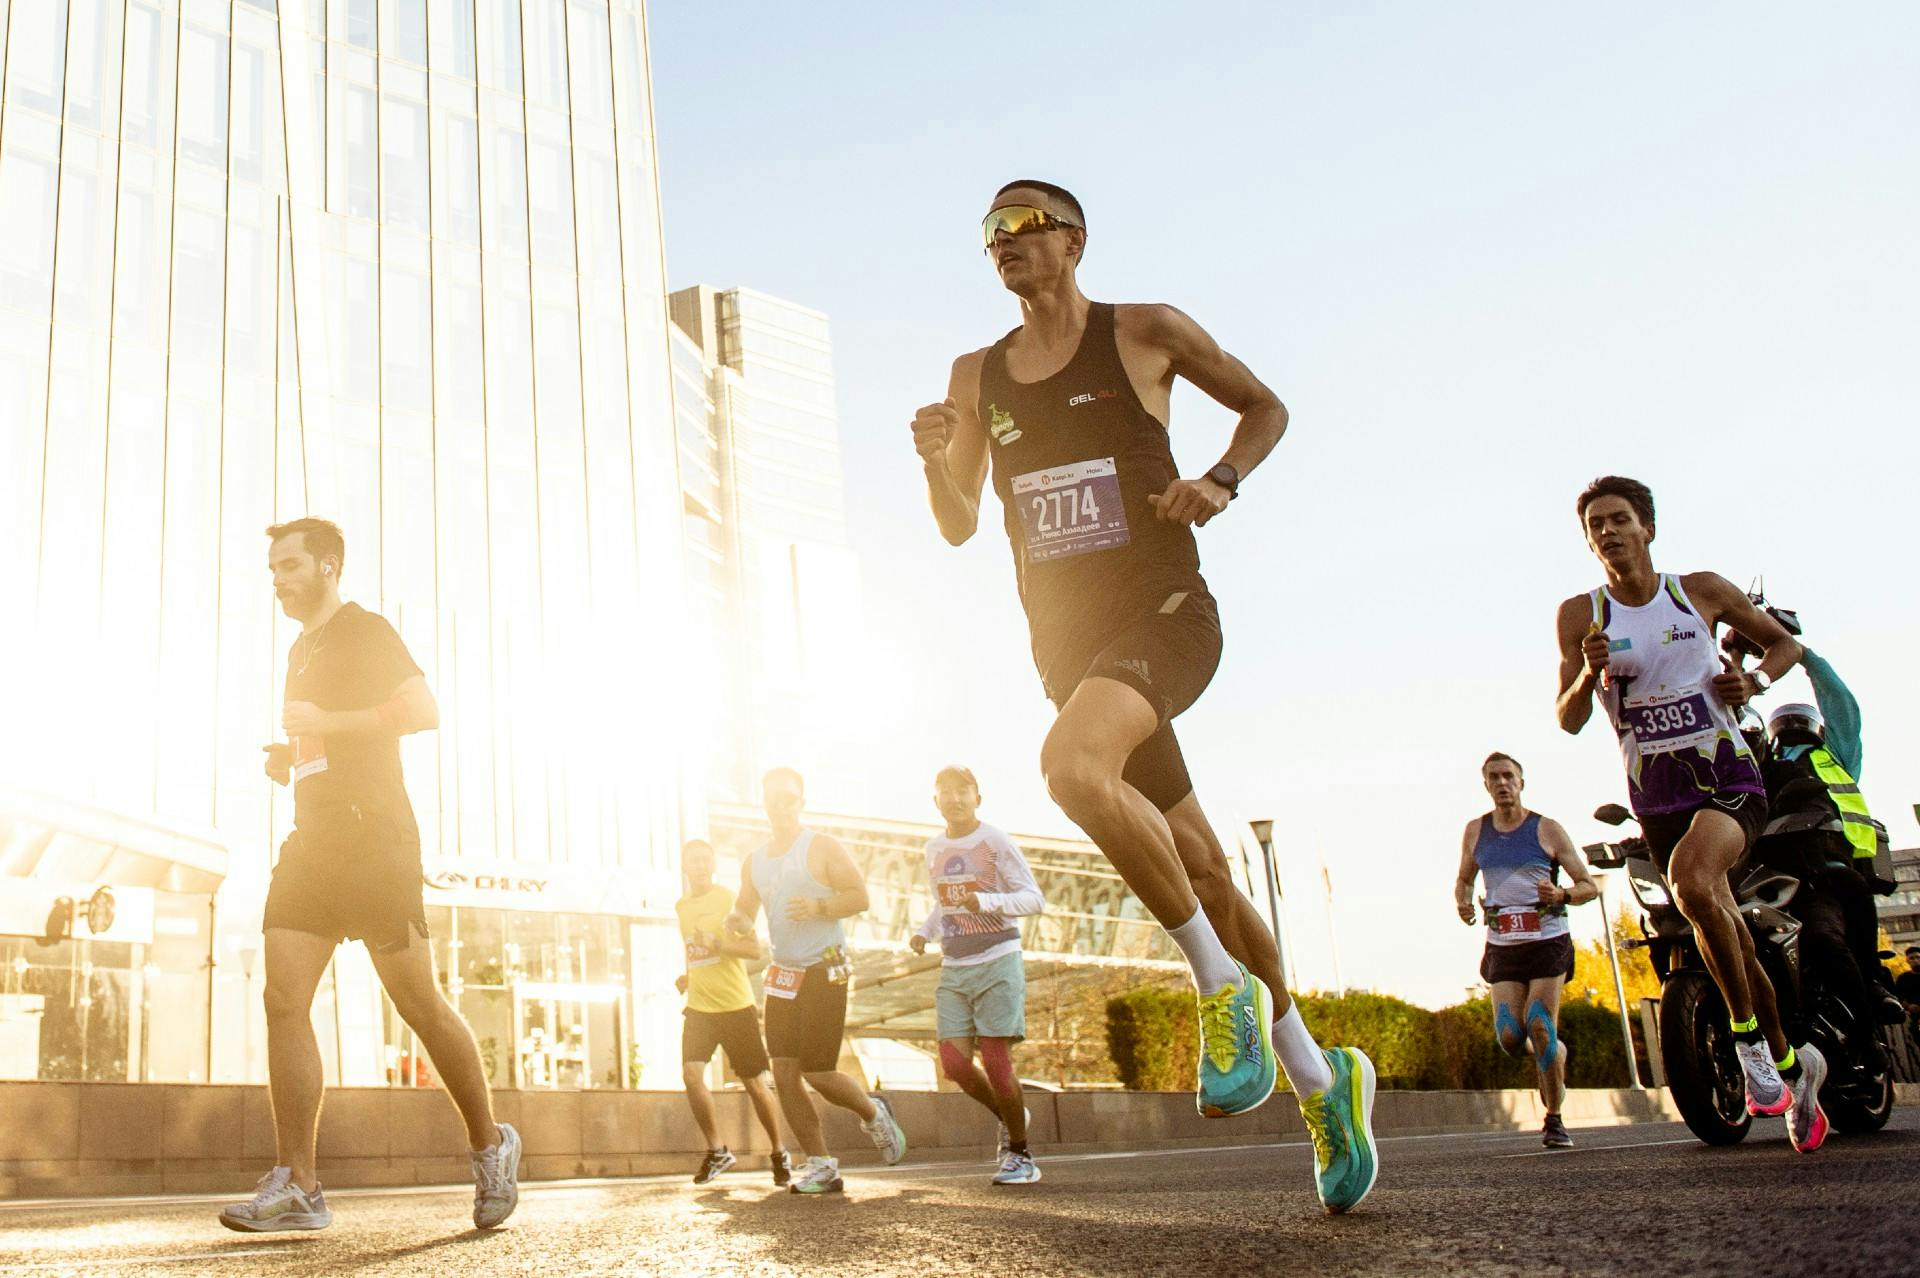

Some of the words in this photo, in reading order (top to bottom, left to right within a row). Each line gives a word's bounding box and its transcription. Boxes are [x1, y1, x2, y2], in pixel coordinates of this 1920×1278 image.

[1032, 485, 1100, 533] 2774
[1642, 702, 1696, 734] 3393
[1510, 914, 1524, 929] 31
[1243, 1006, 1261, 1066] HOKA
